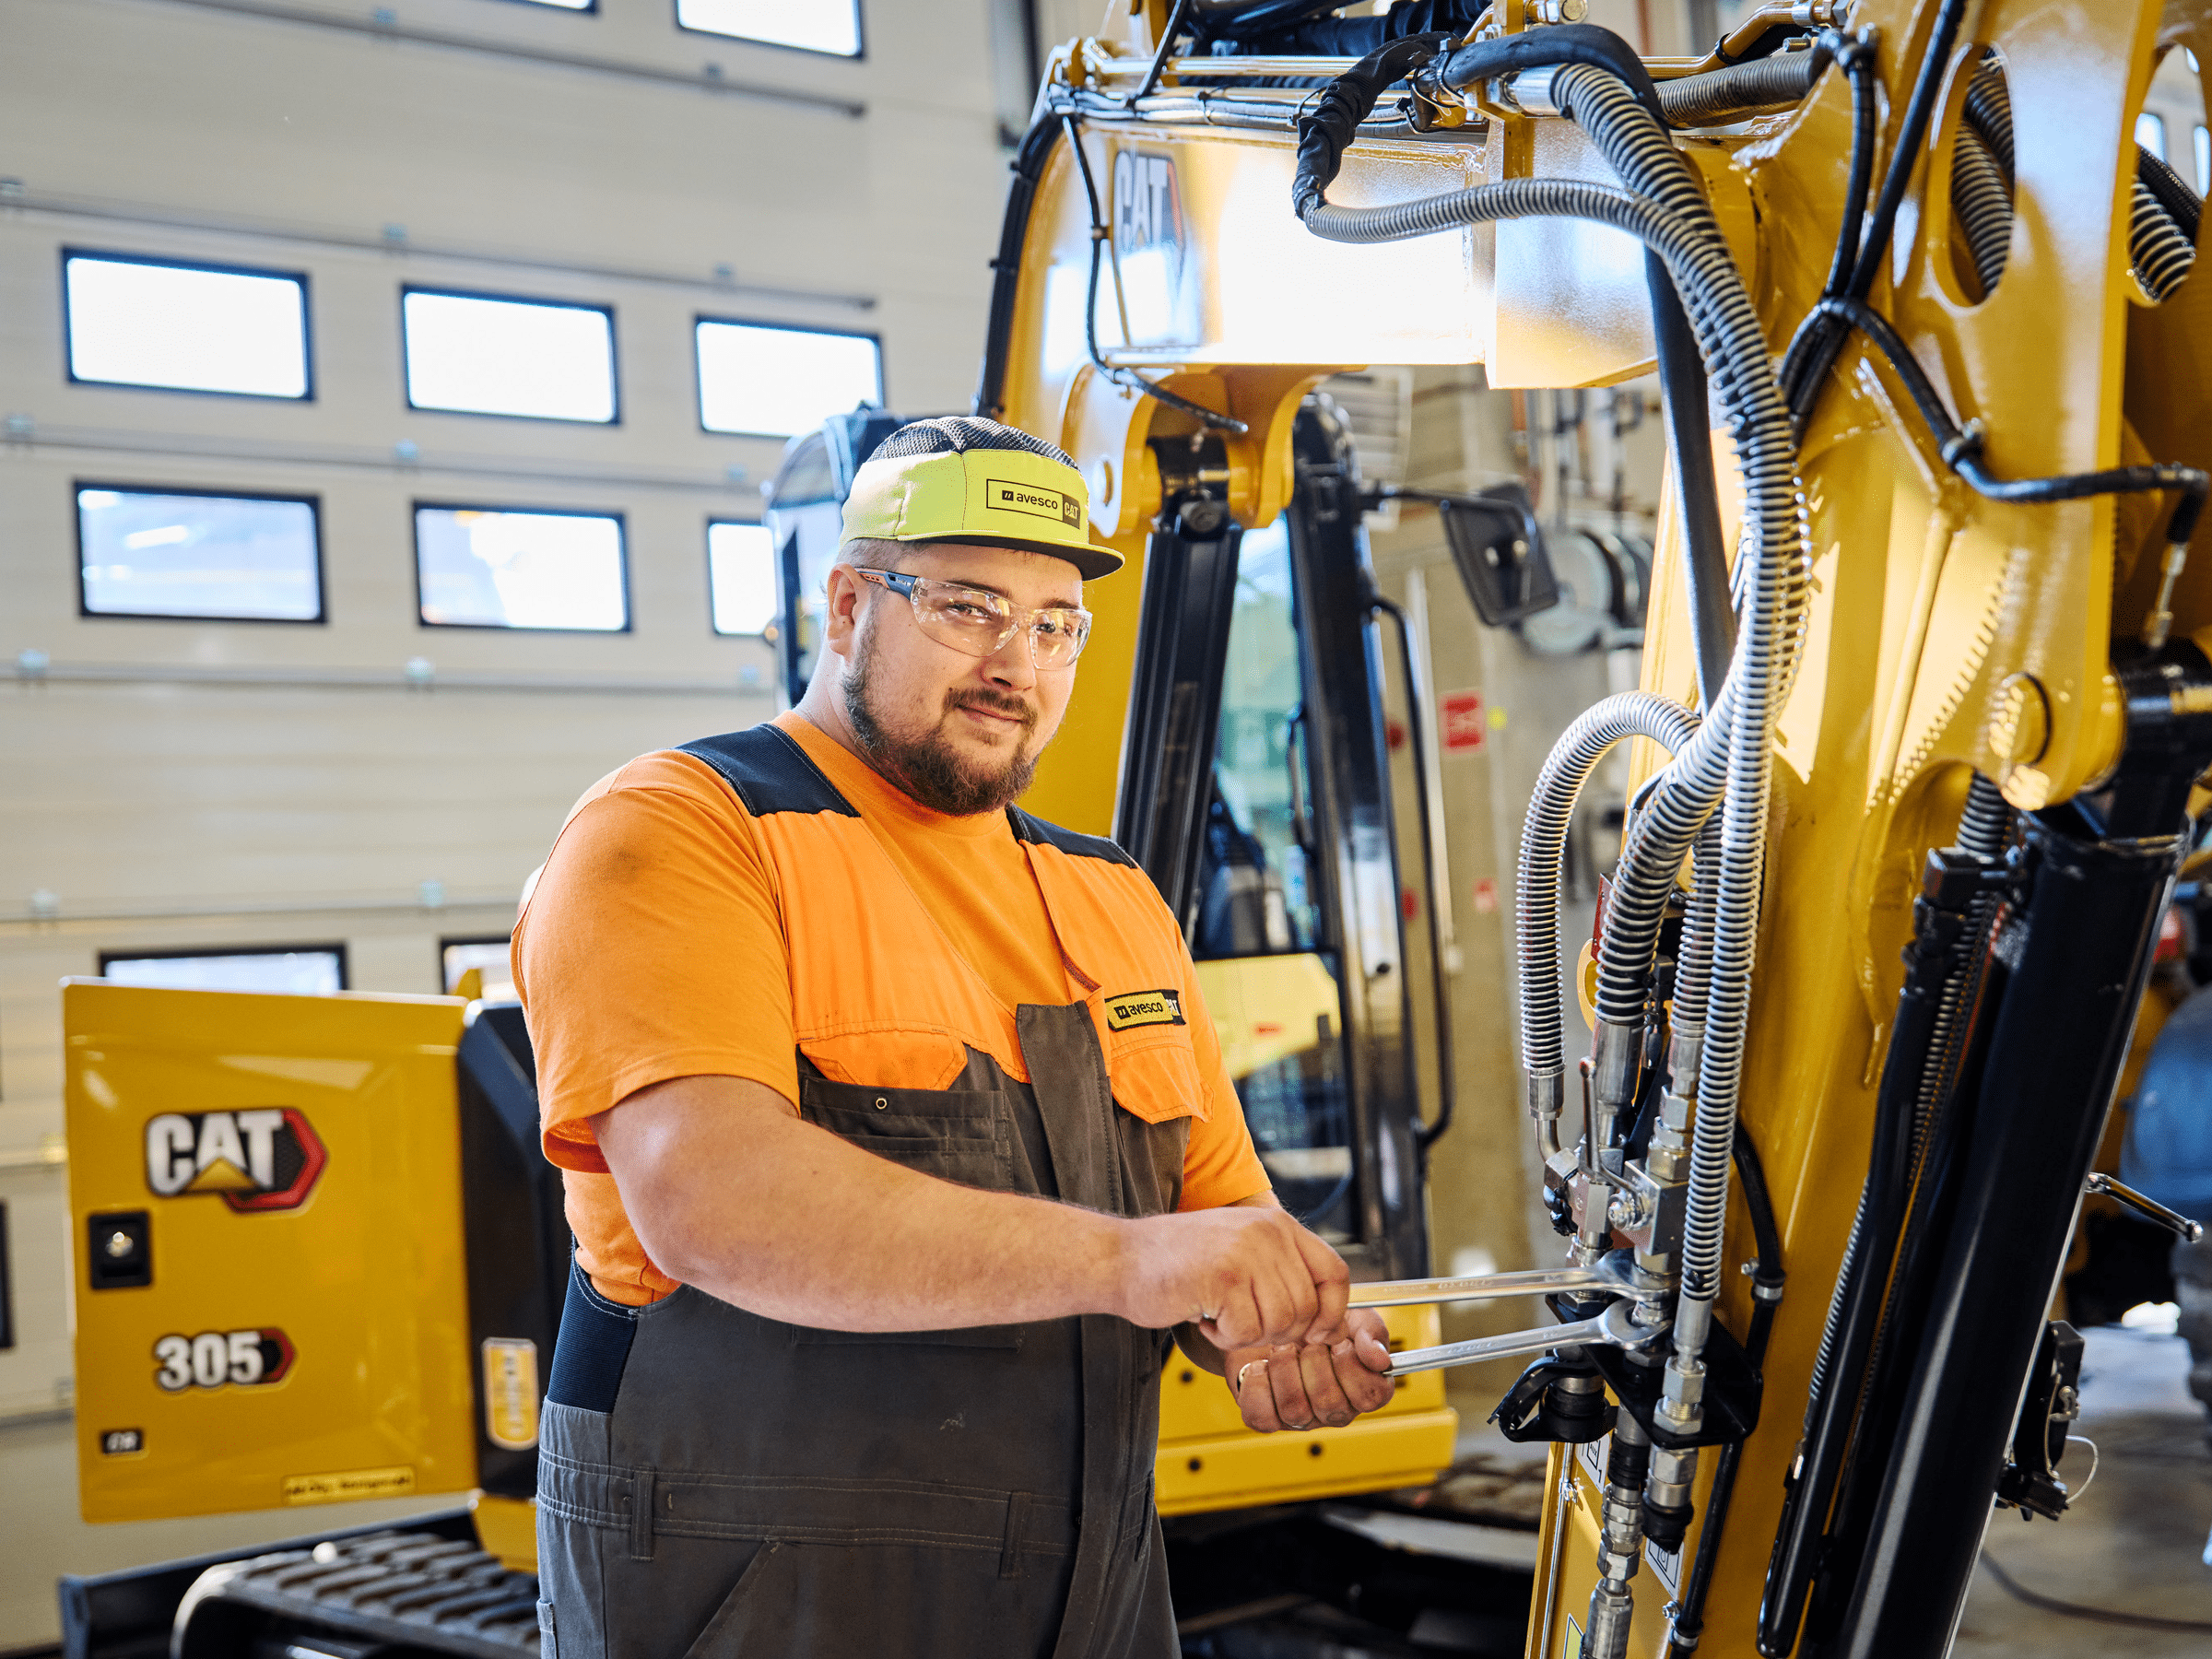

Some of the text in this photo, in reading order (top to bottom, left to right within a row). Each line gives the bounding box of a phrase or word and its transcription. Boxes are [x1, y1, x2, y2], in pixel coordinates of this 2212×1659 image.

[1113, 150, 1169, 251] CAT
[1017, 492, 1078, 520] avesco CAT
[1127, 1002, 1164, 1016] avesco
[146, 1109, 284, 1196] CAT
[155, 1330, 265, 1389] 305
